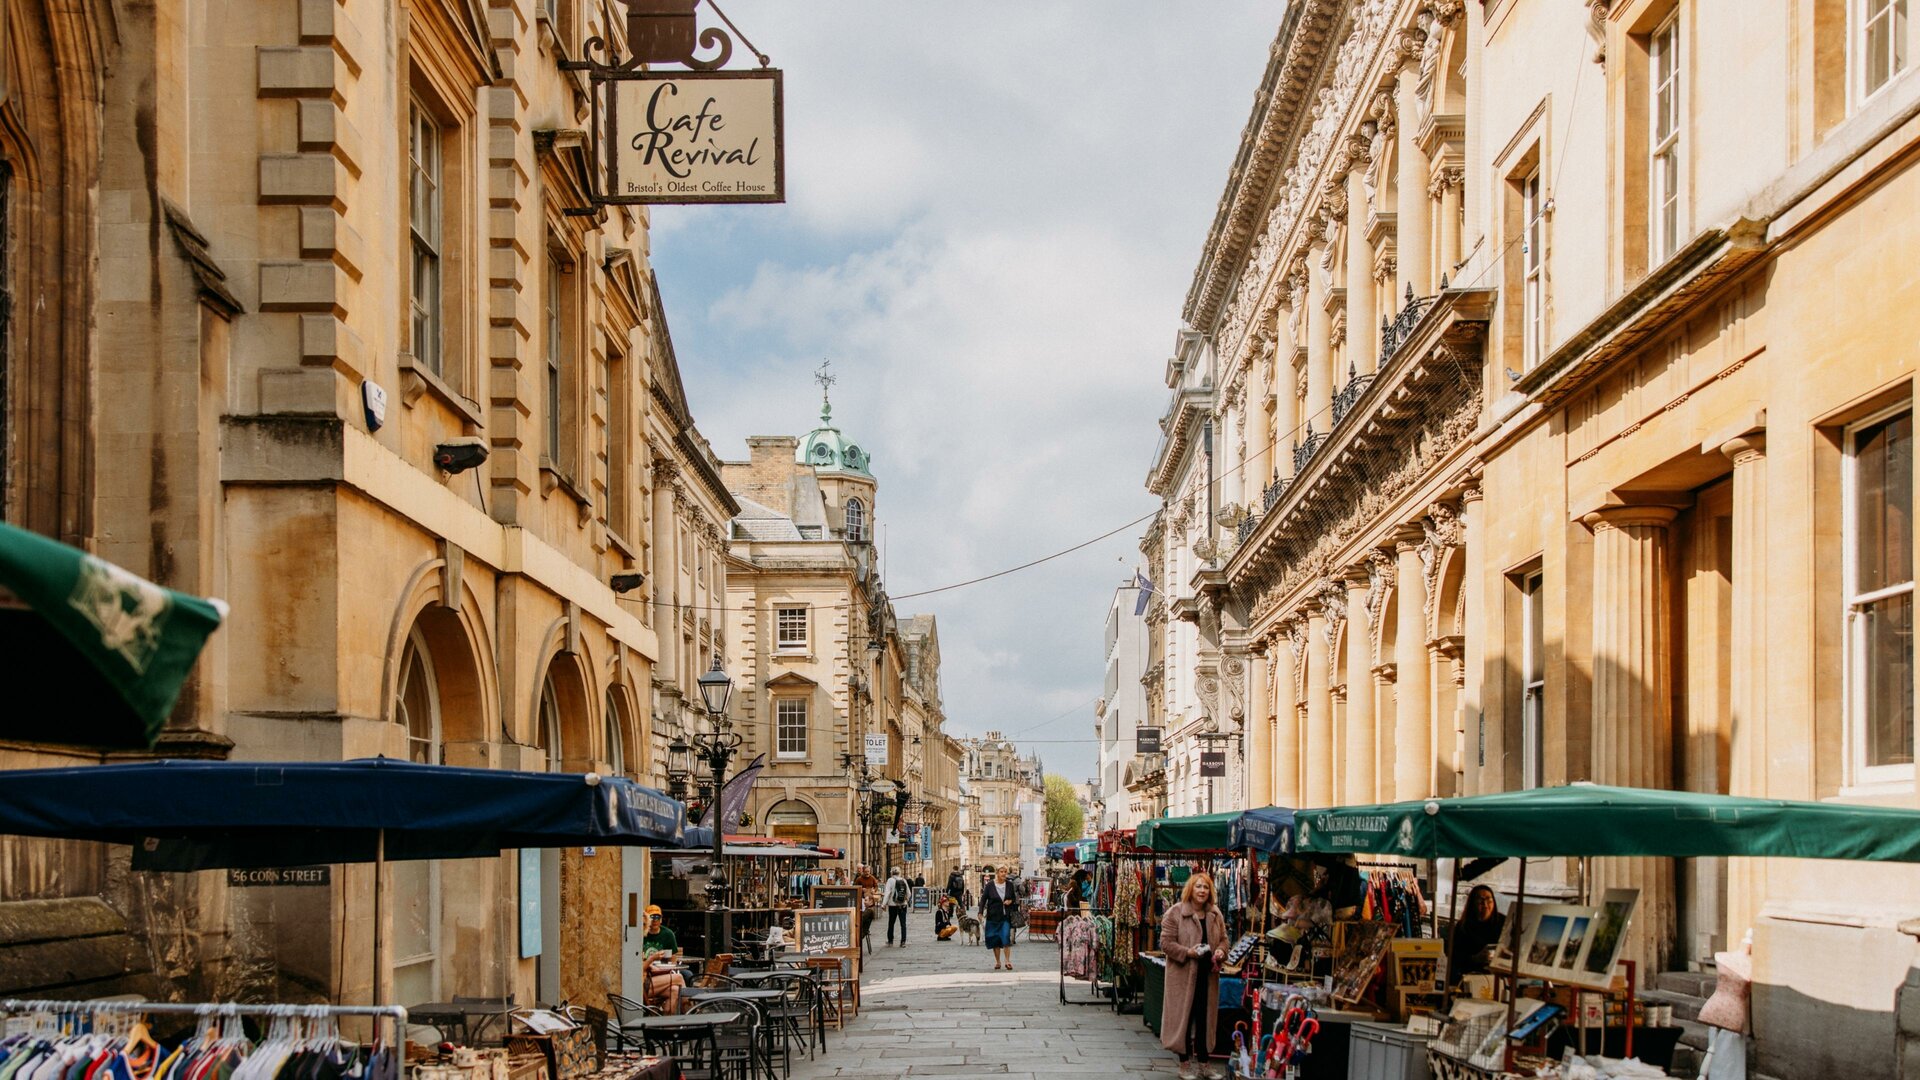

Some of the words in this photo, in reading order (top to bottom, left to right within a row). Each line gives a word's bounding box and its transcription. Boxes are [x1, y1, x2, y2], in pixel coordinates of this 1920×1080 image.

[646, 82, 727, 143] Cafe
[631, 131, 761, 179] Revival
[627, 181, 663, 193] Bristol's
[667, 181, 698, 192] Oldest
[701, 181, 732, 192] Coffee
[736, 181, 766, 192] House
[1325, 814, 1355, 832] NICHOLAS
[1355, 816, 1389, 832] MARKETS
[233, 870, 247, 881] 56
[249, 870, 280, 881] CORN
[282, 870, 323, 881] STREET
[804, 921, 847, 932] REVIVAL
